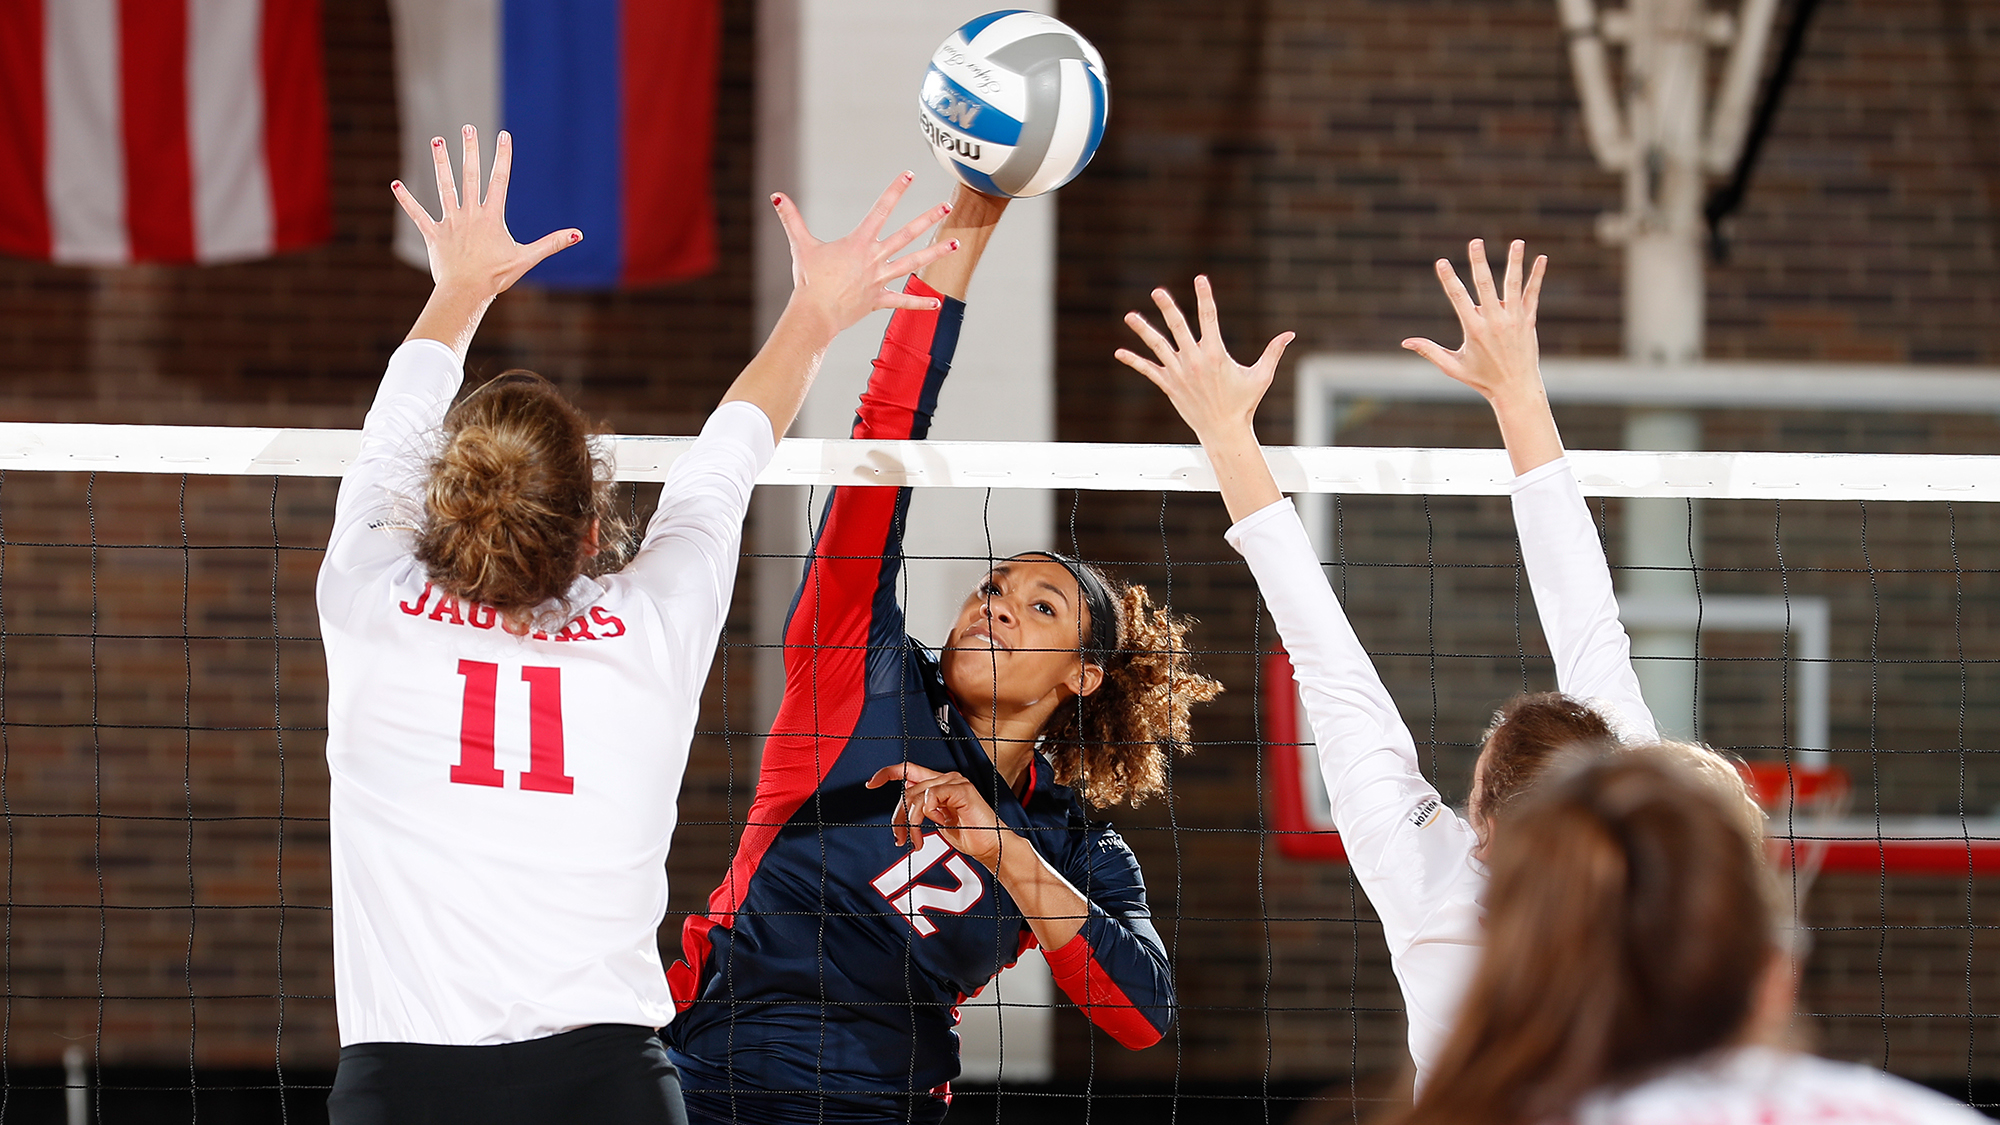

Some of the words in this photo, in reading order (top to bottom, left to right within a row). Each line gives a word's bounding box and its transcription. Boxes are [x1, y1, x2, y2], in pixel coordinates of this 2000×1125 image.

[919, 108, 981, 161] molte
[399, 582, 626, 642] JAGRS
[450, 658, 574, 795] 11
[1413, 799, 1439, 828] HORIZON
[869, 832, 986, 939] 12
